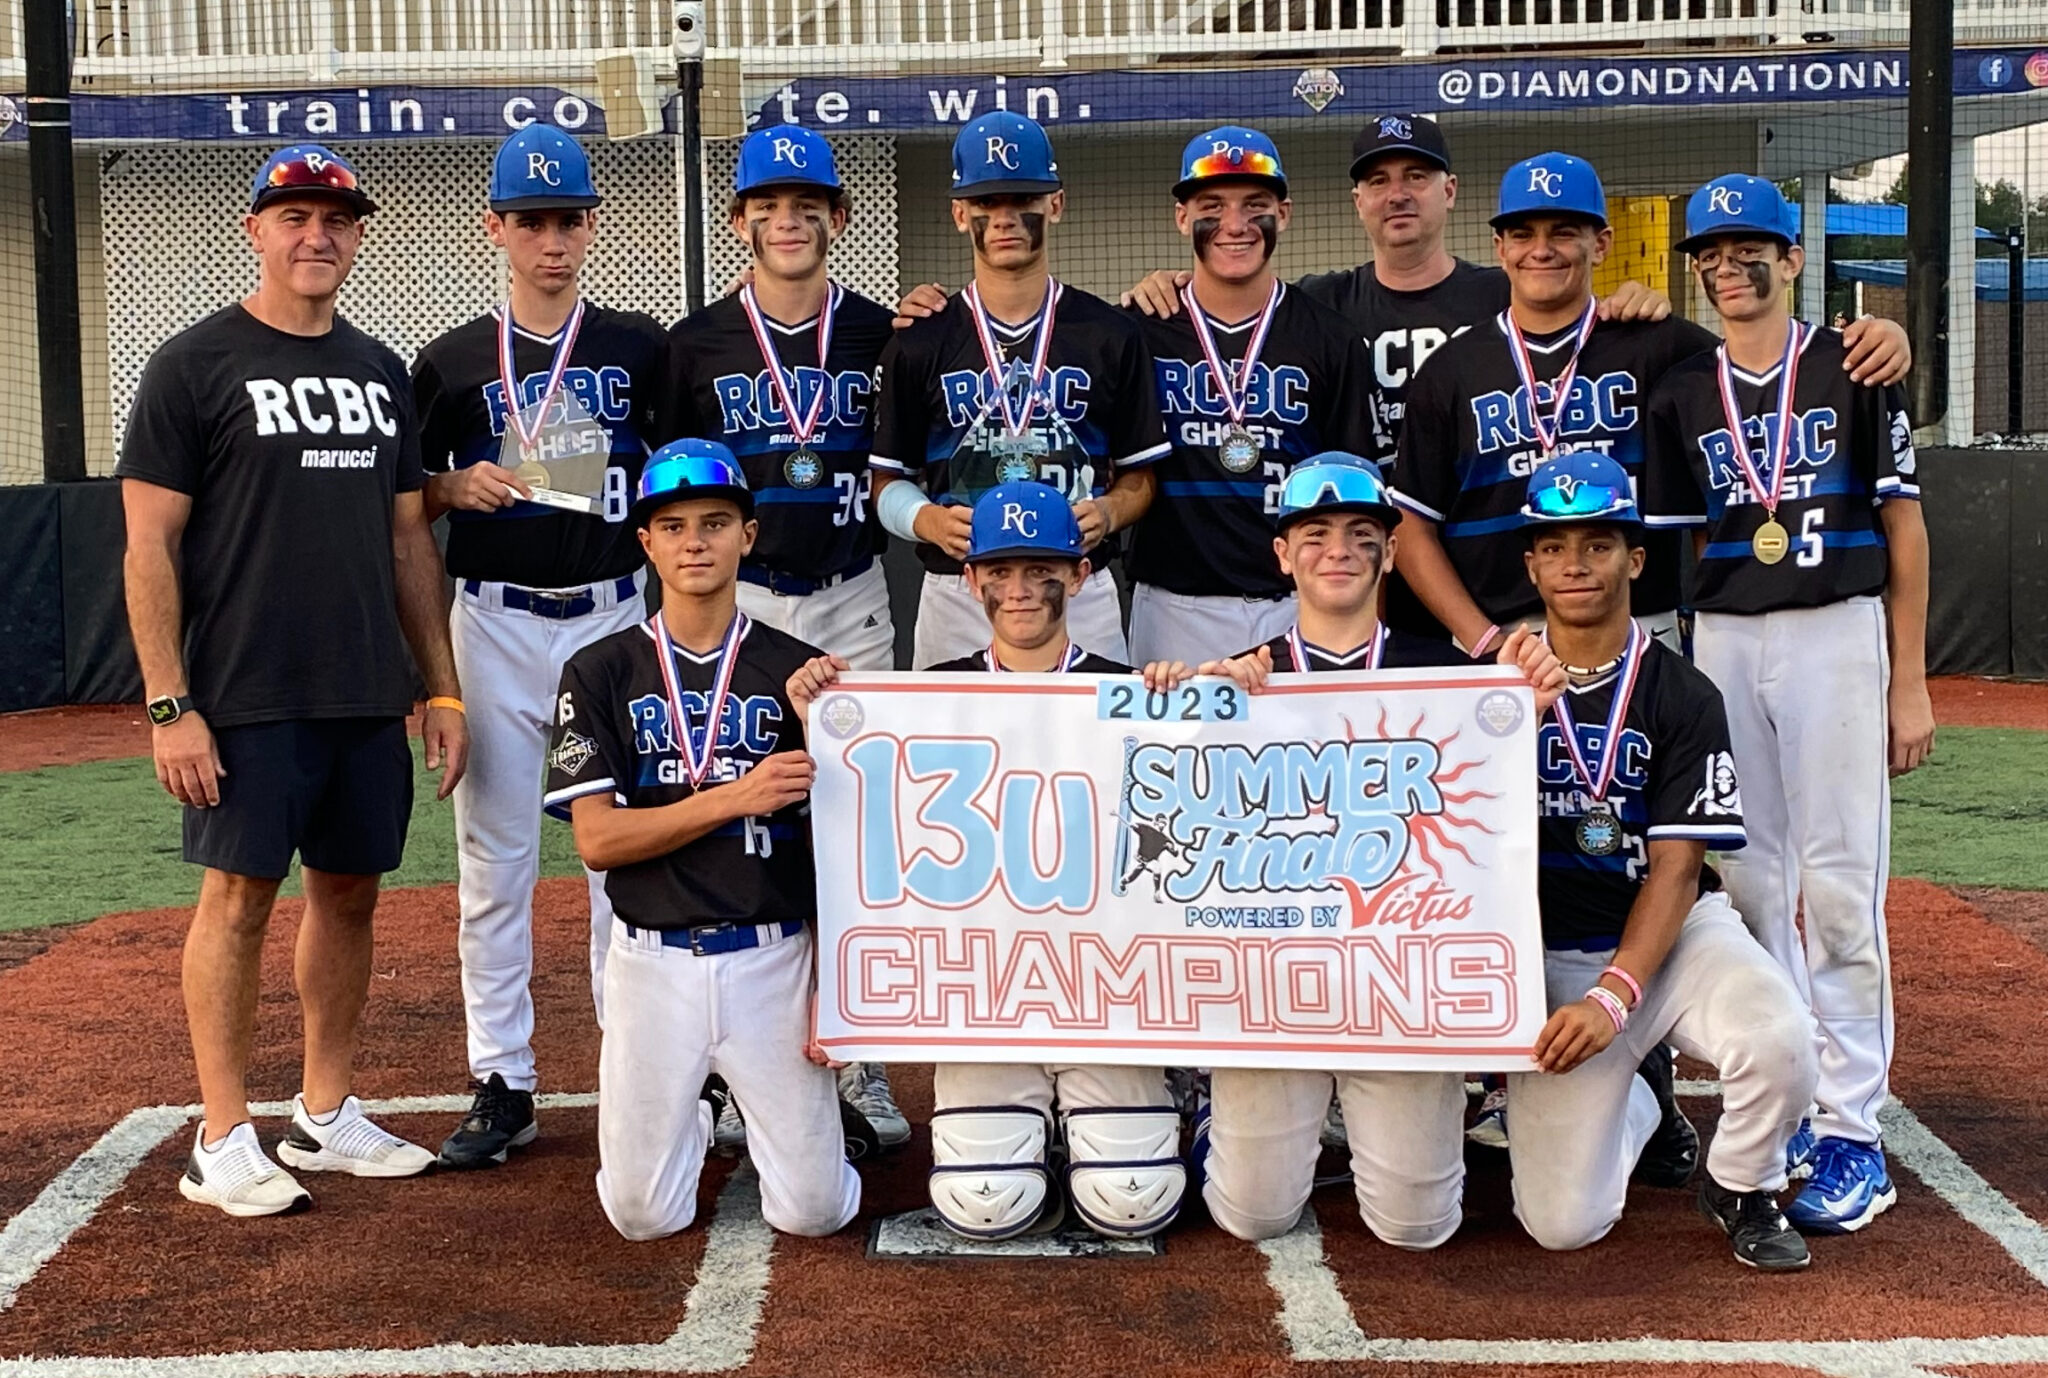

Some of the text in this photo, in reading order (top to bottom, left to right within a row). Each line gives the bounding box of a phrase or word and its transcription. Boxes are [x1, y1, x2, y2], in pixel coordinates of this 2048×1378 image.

[1292, 84, 1345, 97] NATION
[1438, 60, 1911, 104] @DIAMONDNATIONN
[226, 88, 455, 134] train.
[928, 75, 1091, 121] win.
[1377, 116, 1413, 140] RC
[526, 152, 560, 186] RC
[773, 137, 808, 168] RC
[985, 136, 1019, 170] RC
[1527, 167, 1563, 198] RC
[1708, 186, 1743, 215] RC
[1363, 325, 1473, 388] CB
[245, 377, 397, 437] RCBC
[482, 366, 631, 437] RCBC
[714, 366, 871, 434] RCBC
[1153, 356, 1310, 425] RCBC
[1470, 371, 1639, 454] RCBC
[301, 445, 377, 468] marucci
[962, 424, 1073, 452] GHST
[1508, 440, 1615, 477] GHT
[1725, 473, 1817, 506] HST
[1000, 502, 1038, 538] RC
[1796, 507, 1825, 567] 5
[628, 690, 784, 755] RCBC
[1109, 684, 1238, 721] 2023
[1538, 723, 1653, 791] CBC
[1130, 738, 1444, 822] SUMMER
[1538, 790, 1627, 819] HOST
[1185, 875, 1474, 931] POWERED BY Victus
[837, 926, 1517, 1038] CHAMPIONS
